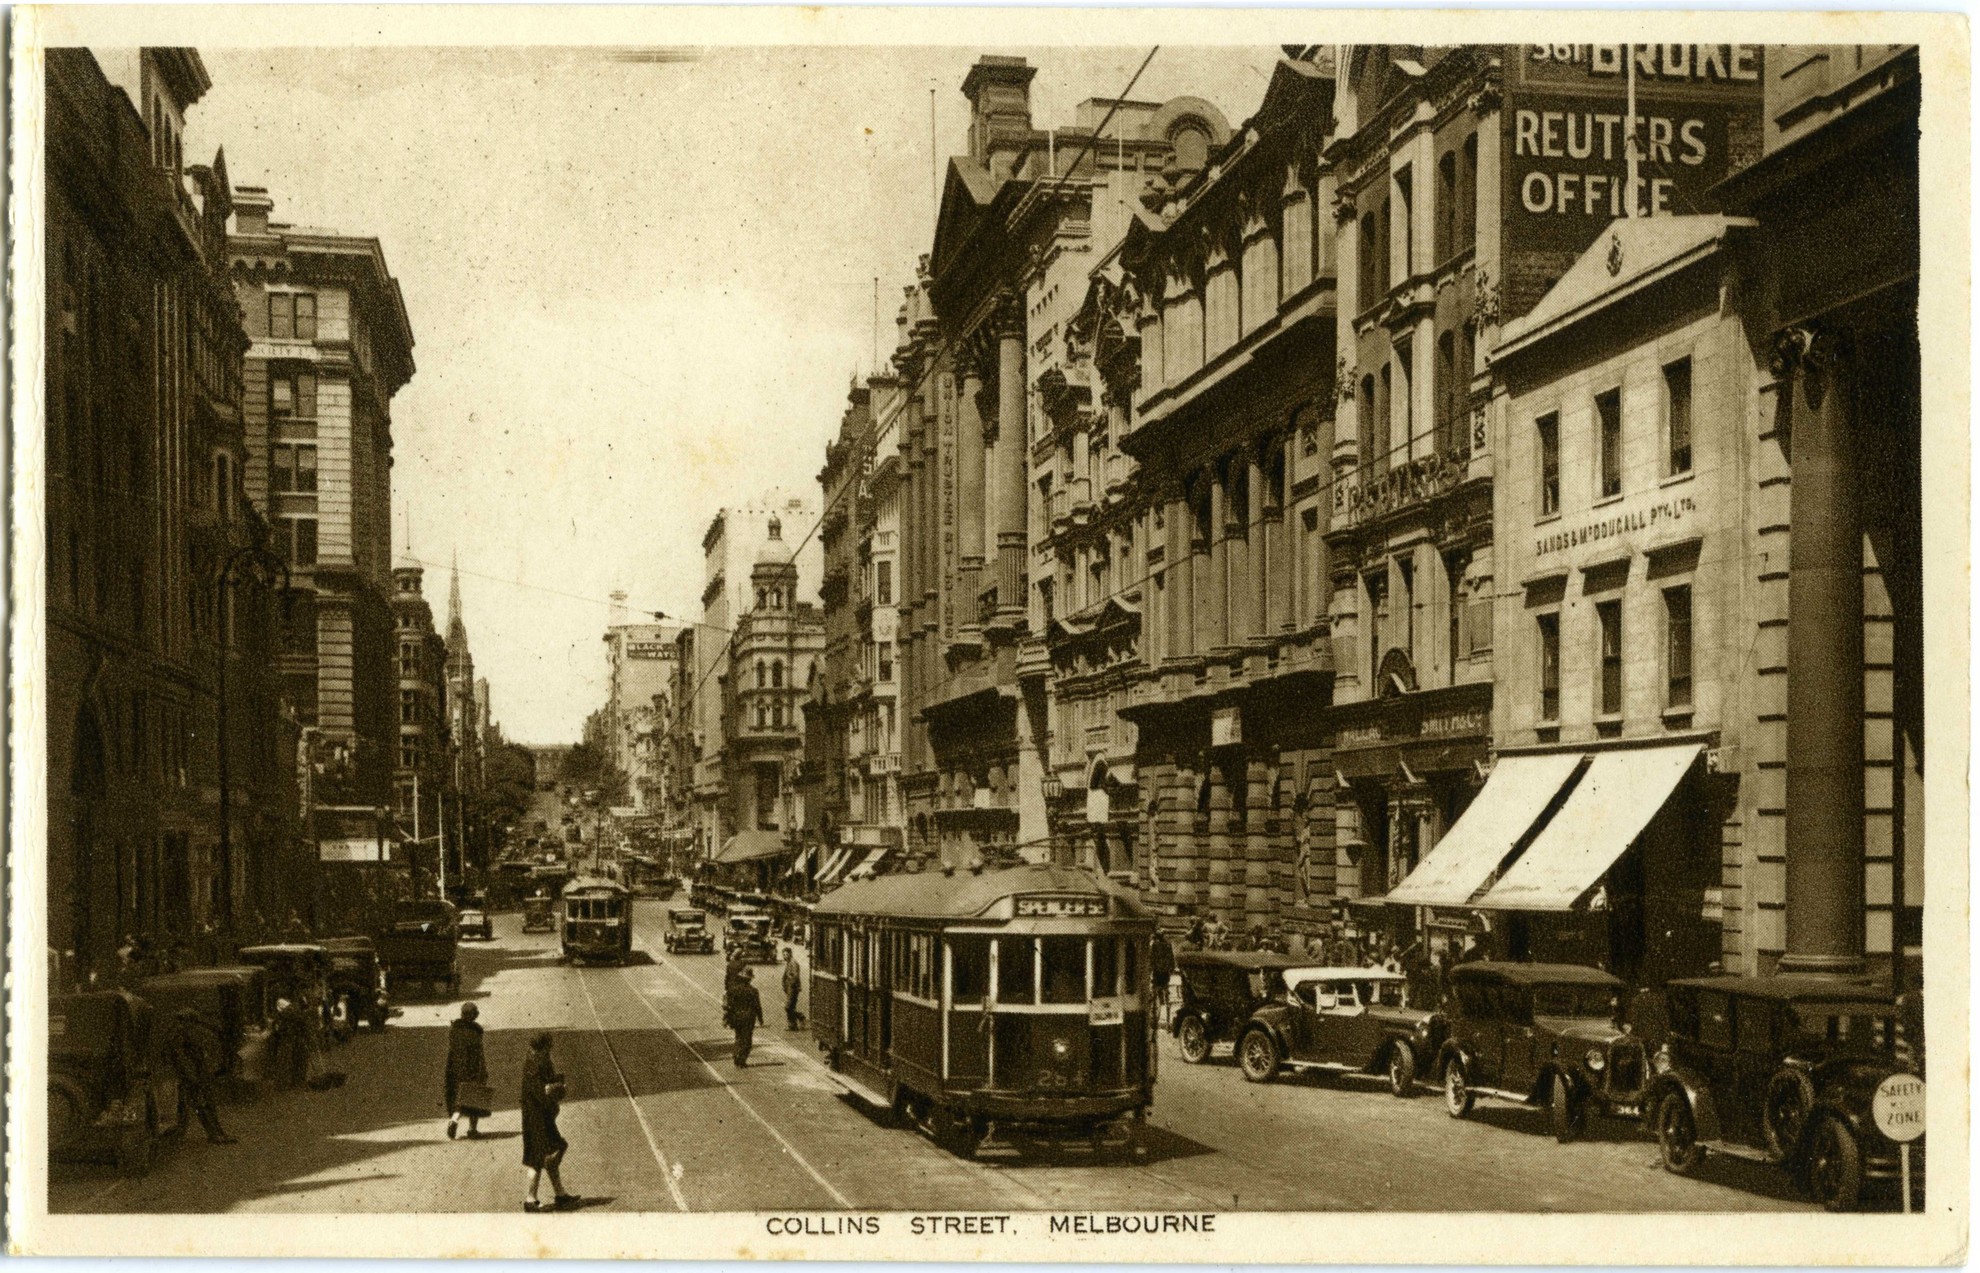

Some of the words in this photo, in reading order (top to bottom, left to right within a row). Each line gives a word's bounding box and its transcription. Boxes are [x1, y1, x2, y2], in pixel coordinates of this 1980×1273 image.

[1515, 109, 1707, 165] REUTERS
[1880, 1082, 1921, 1097] SAFETY
[1886, 1110, 1921, 1125] ZONE
